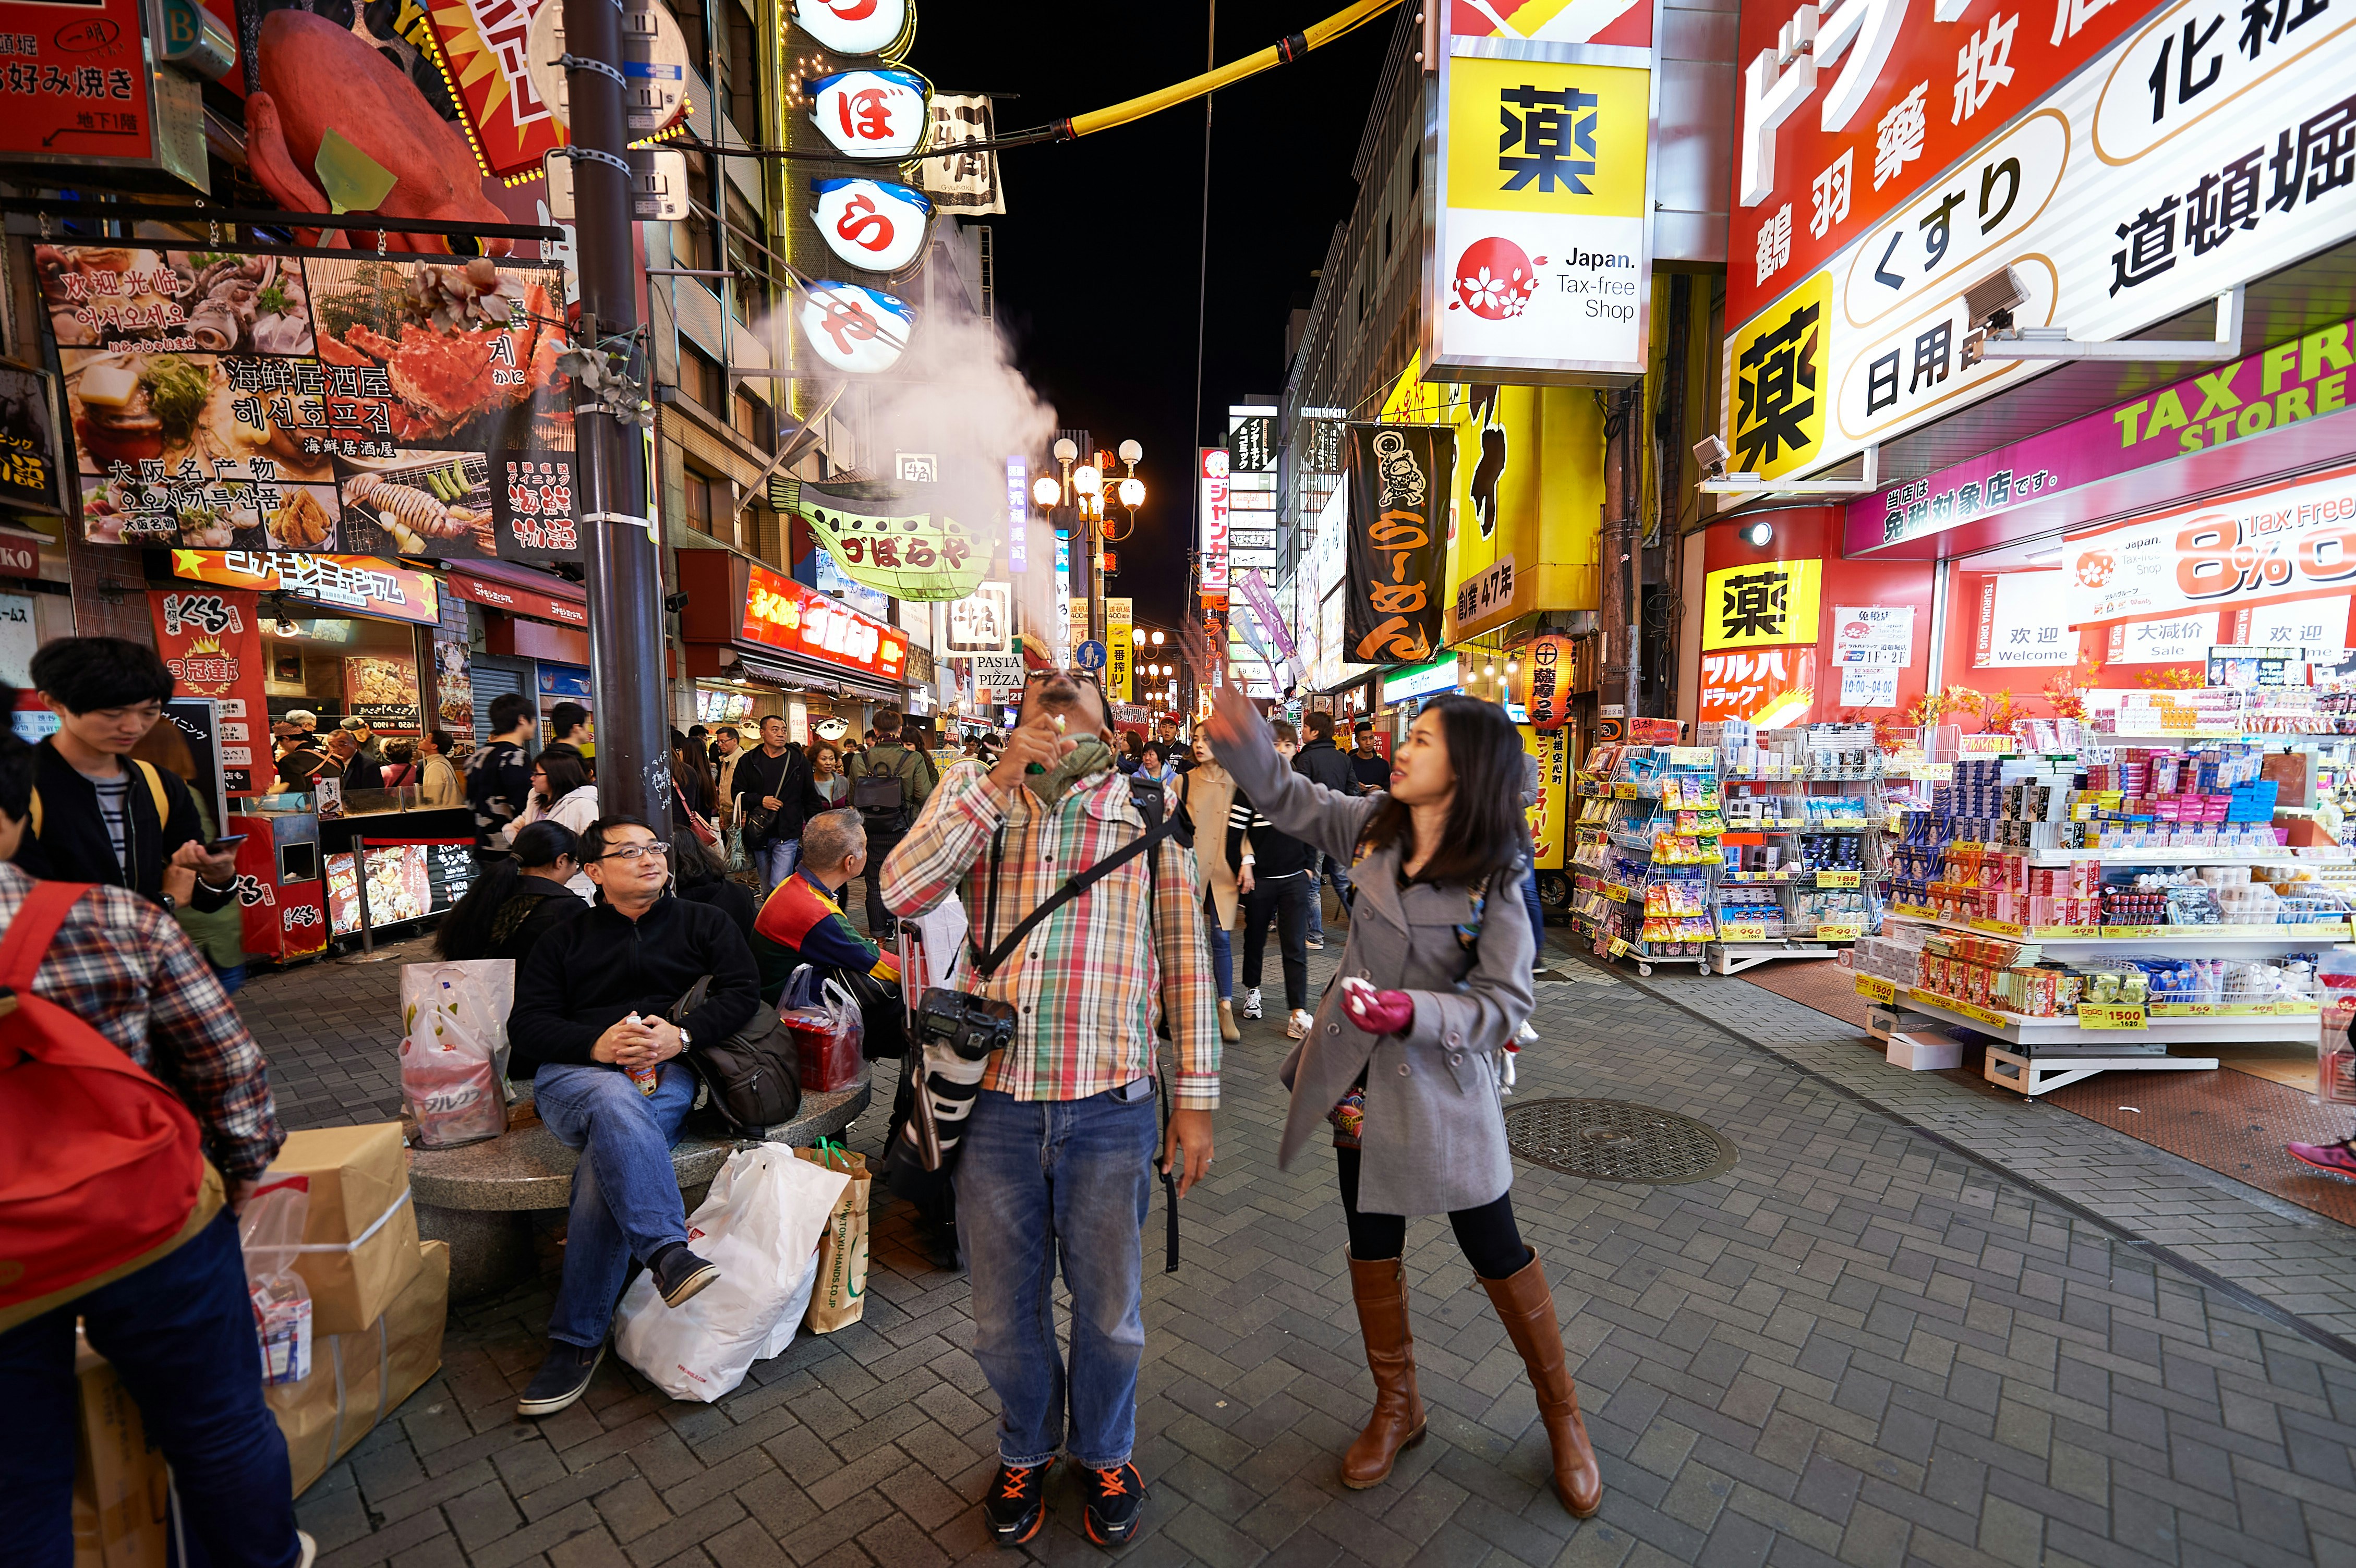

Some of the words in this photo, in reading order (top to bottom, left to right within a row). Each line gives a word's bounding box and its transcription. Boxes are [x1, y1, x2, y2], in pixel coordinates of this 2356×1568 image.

[170, 9, 195, 42] B
[0, 62, 132, 100] 好み焼き
[76, 111, 138, 131] 地下1階
[1499, 84, 1598, 195] 薬
[2109, 93, 2356, 299] 道頓堀
[1874, 156, 2022, 291] くすり
[1565, 247, 1636, 272] Japan.
[60, 268, 180, 300] 欢迎光临
[1556, 274, 1636, 296] Tax-free
[76, 303, 191, 334] 어서오세요
[1585, 299, 1635, 323] Shop
[108, 337, 196, 354] いらっしゃいませ
[493, 370, 524, 384] かに
[1736, 300, 1821, 473] 薬
[232, 396, 392, 435] 해선호프집
[2113, 360, 2244, 449] TAX
[2178, 371, 2348, 457] STORE
[304, 437, 397, 459] 海鮮居酒屋
[1250, 418, 1260, 470] インターネット
[0, 453, 45, 490] 語
[108, 457, 277, 486] 大阪名产物
[508, 473, 570, 485] ダイニング
[508, 484, 571, 517] 海鮮
[1883, 468, 2058, 543] 免税対象店です。
[1886, 478, 1929, 510] 当店は
[123, 517, 177, 532] 大阪名物
[1210, 482, 1228, 581] ジャンカラ
[2243, 504, 2294, 539] Tax
[2297, 494, 2356, 528] Free
[512, 518, 577, 549] 物語
[1356, 508, 1431, 661] らーめん
[2136, 564, 2161, 576] Shop
[1457, 564, 1513, 621] 創業47年
[1722, 571, 1788, 639] 薬
[1982, 582, 1993, 623] TSURUHA
[0, 607, 28, 623] ームス
[178, 597, 229, 633] くくる
[953, 601, 999, 637] 牛角
[1108, 605, 1131, 613] 道頓堀
[1260, 601, 1291, 645] ZAZA
[1979, 626, 1991, 650] DRUG
[2010, 627, 2058, 644] 欢迎
[2137, 622, 2203, 641] 大减价
[2269, 625, 2323, 642] 欢迎
[977, 657, 1021, 668] PASTA
[1114, 643, 1126, 685] 一番搾り
[1998, 648, 2068, 661] Welcome
[2151, 646, 2184, 657] Sale
[166, 658, 239, 682] 3冠達成
[979, 674, 1021, 686] PIZZA
[1703, 652, 1786, 684] ツルハ
[1703, 686, 1763, 708] ドラッグ
[1963, 737, 2012, 752] アルバイト募集
[291, 906, 316, 926] くくる
[1871, 983, 1892, 996] 1500
[2108, 1011, 2142, 1021] 1500
[828, 1200, 853, 1308] WWW.TOKYU-HANDS.CO.JP
